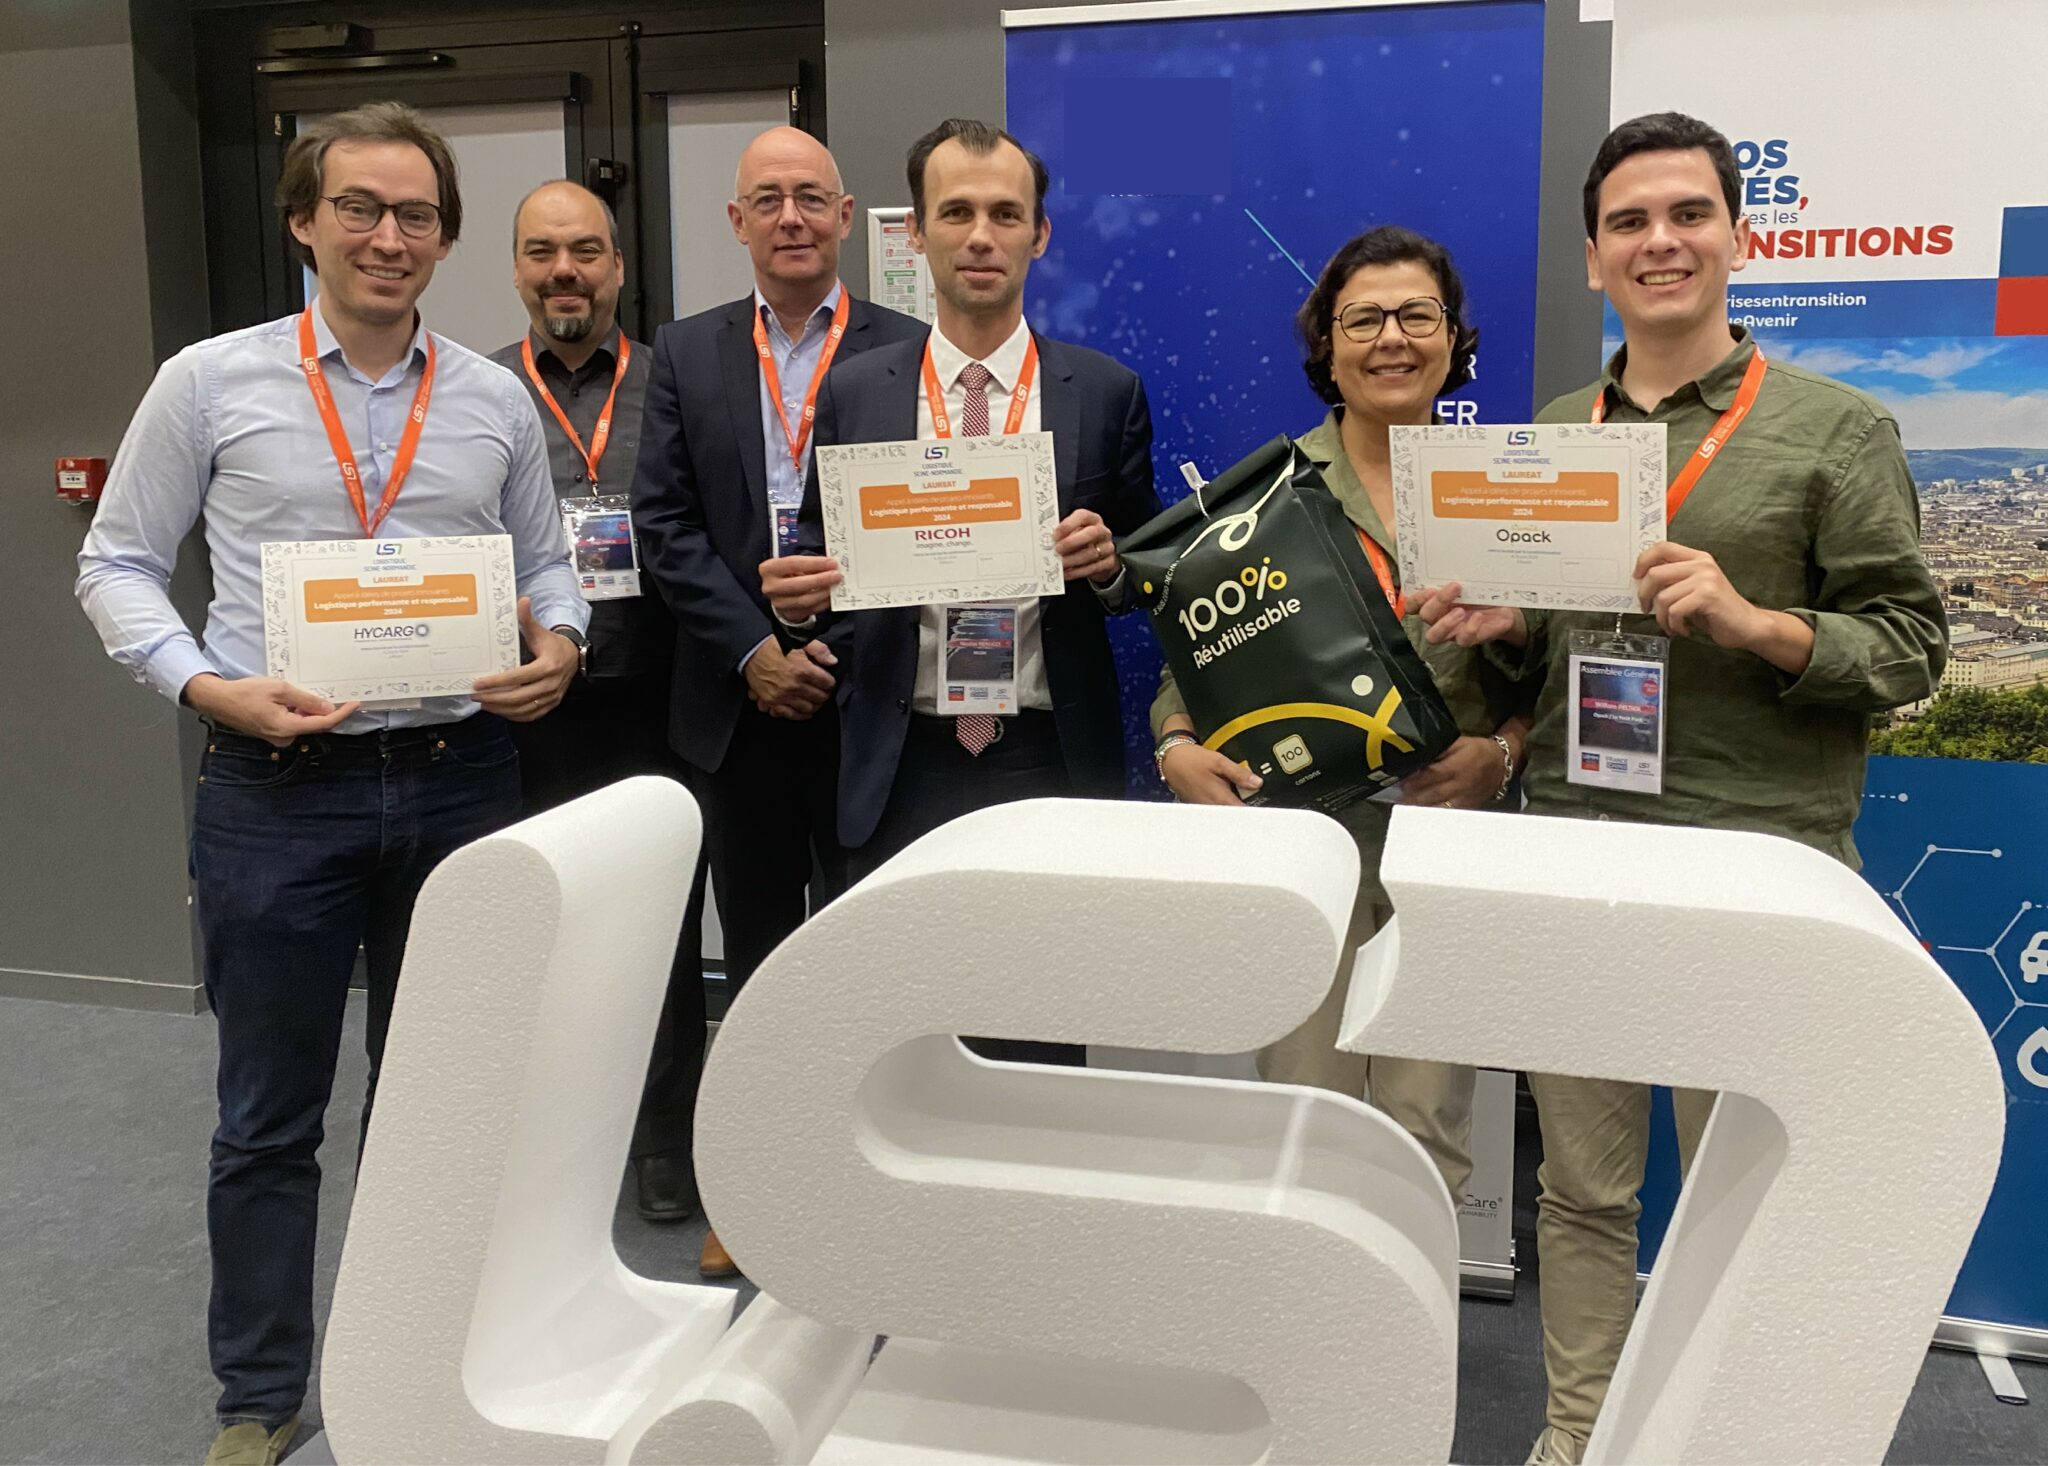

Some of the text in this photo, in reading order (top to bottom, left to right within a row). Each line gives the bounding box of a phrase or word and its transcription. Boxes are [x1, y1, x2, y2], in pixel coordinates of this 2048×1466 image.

[1741, 168, 1809, 210] ÉS,
[1774, 209, 1799, 224] les
[1747, 225, 1954, 260] NSITIONS
[869, 501, 1013, 517] Logistique performante et responsable
[1441, 496, 1609, 509] Logistique performante et responsable
[915, 527, 970, 541] RICOH
[1496, 529, 1552, 543] Opack
[314, 597, 469, 611] Logistique performante et responsable
[1178, 557, 1288, 641] 100%
[354, 624, 430, 640] HYCARGO
[1193, 598, 1301, 670] Réutilisable
[1280, 746, 1303, 763] 100
